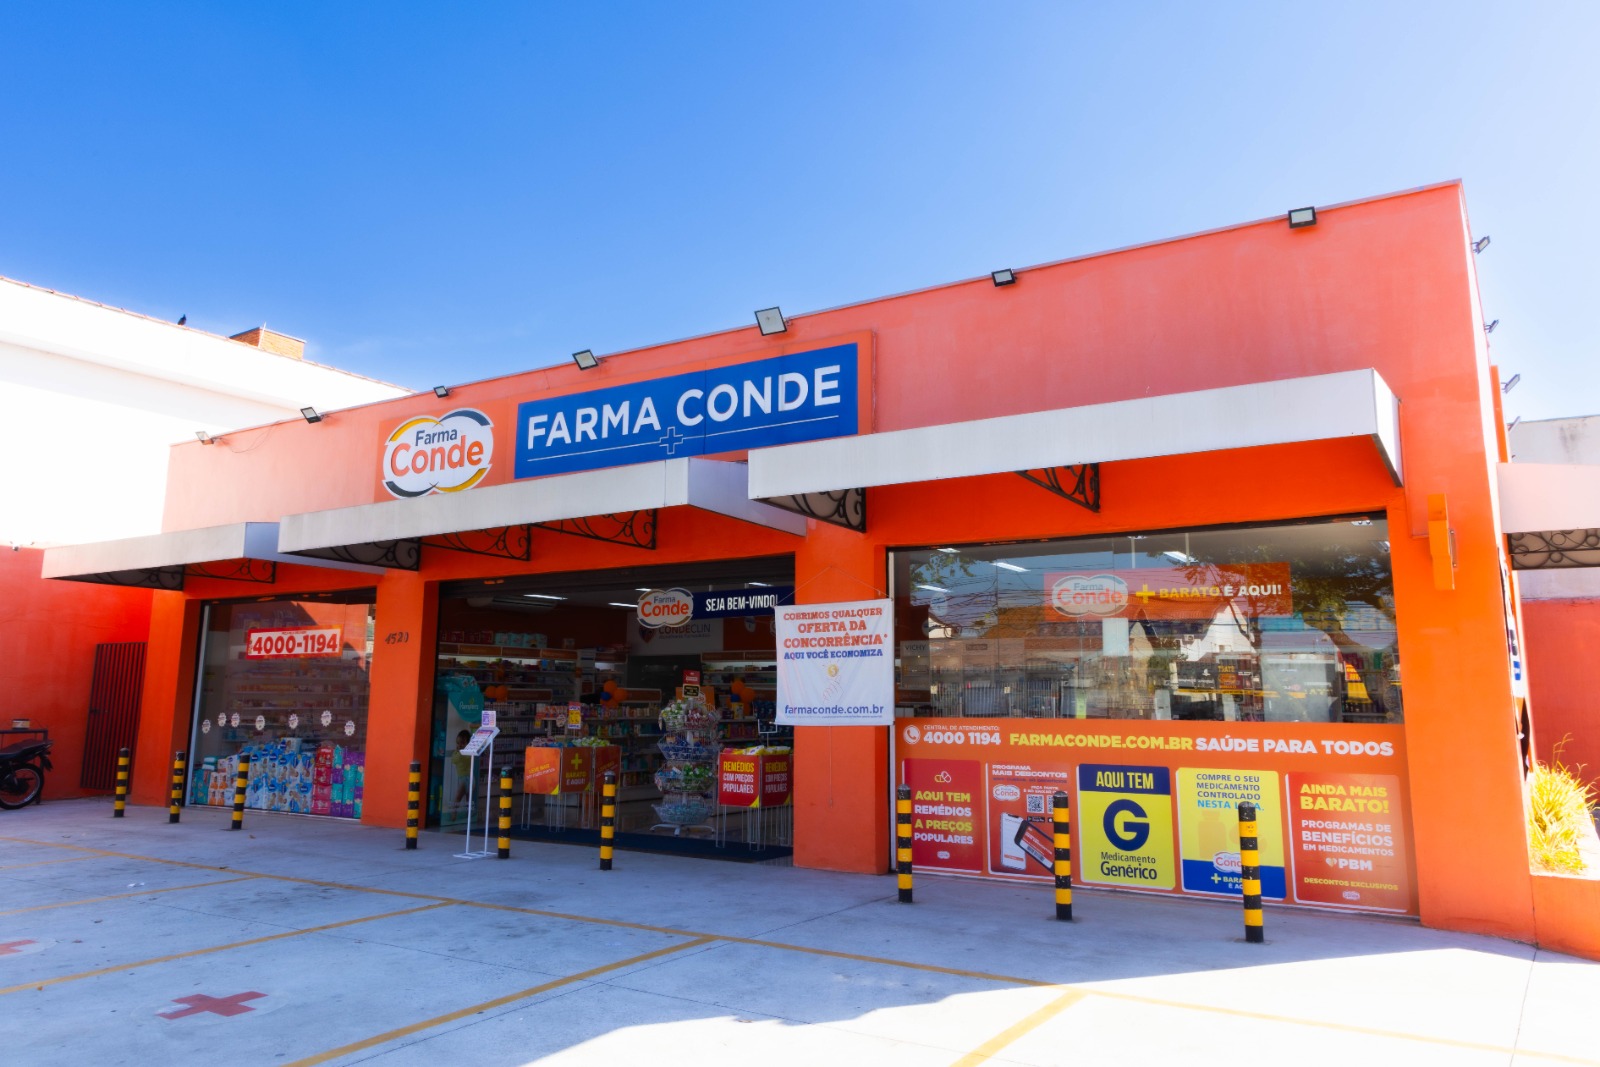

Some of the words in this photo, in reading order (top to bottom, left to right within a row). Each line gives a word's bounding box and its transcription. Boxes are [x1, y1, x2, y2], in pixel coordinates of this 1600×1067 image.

[527, 396, 662, 450] FARMA
[676, 364, 841, 427] CONDE
[415, 428, 458, 447] Farma
[390, 434, 484, 477] Conde
[1073, 582, 1104, 591] Farma
[1159, 586, 1220, 599] BARATO
[1237, 584, 1282, 596] AQUI!
[653, 595, 676, 604] Farma
[705, 598, 726, 612] SEJA
[727, 594, 778, 611] BEM-VINDO!
[1057, 587, 1123, 606] Conde
[640, 600, 690, 617] Conde
[783, 611, 830, 621] COBRIMOS
[831, 607, 883, 619] QUALQUER
[797, 621, 847, 633] OFERTA
[849, 620, 867, 631] DA
[252, 633, 338, 655] 4000-1194
[783, 652, 805, 660] AQUI
[806, 649, 829, 659] VOCÊ
[830, 648, 883, 658] ECONOMIZA
[784, 704, 884, 715] farmaconde.com.br
[923, 731, 965, 744] 4000
[967, 732, 1001, 745] 1194
[1009, 733, 1193, 750] FARMACONDE.COM.BR
[1195, 735, 1260, 752] SAÚDE
[1263, 739, 1318, 754] PARA
[1321, 740, 1395, 756] TODOS
[723, 761, 755, 773] REMÉDIOS
[722, 772, 735, 782] COM
[735, 773, 754, 784] PREÇOS
[1095, 771, 1125, 788] AQUI
[1127, 772, 1154, 790] TEM
[1196, 773, 1232, 782] COMPRE
[1243, 775, 1260, 783] SEU
[722, 783, 754, 794] POPULARES
[1196, 782, 1260, 792] MEDICAMENTO
[1300, 783, 1347, 796] AINDA
[1349, 785, 1388, 798] MAIS
[915, 790, 944, 801] AQUI
[946, 792, 971, 803] TEM
[1197, 790, 1261, 800] CONTROLADO
[914, 803, 972, 817] REMÉDIOS
[1197, 799, 1231, 809] NESTA
[1300, 795, 1390, 814] BARATO!
[914, 818, 924, 829] A
[925, 820, 973, 832] PREÇOS
[1103, 798, 1150, 852] G
[1301, 819, 1373, 832] PROGRAMAS
[1375, 824, 1392, 833] DE
[914, 832, 974, 845] POPULARES
[1301, 830, 1393, 847] BENEFÍCIOS
[1302, 843, 1316, 851] EM
[1318, 844, 1395, 857] MEDICAMENTOS
[1101, 852, 1156, 864] Medicamento
[1215, 857, 1242, 867] Con
[1338, 858, 1373, 872] PBM
[1100, 861, 1158, 880] Genérico
[1303, 877, 1350, 887] DESCONTOS
[1350, 881, 1399, 891] EXCLUSIVOS
